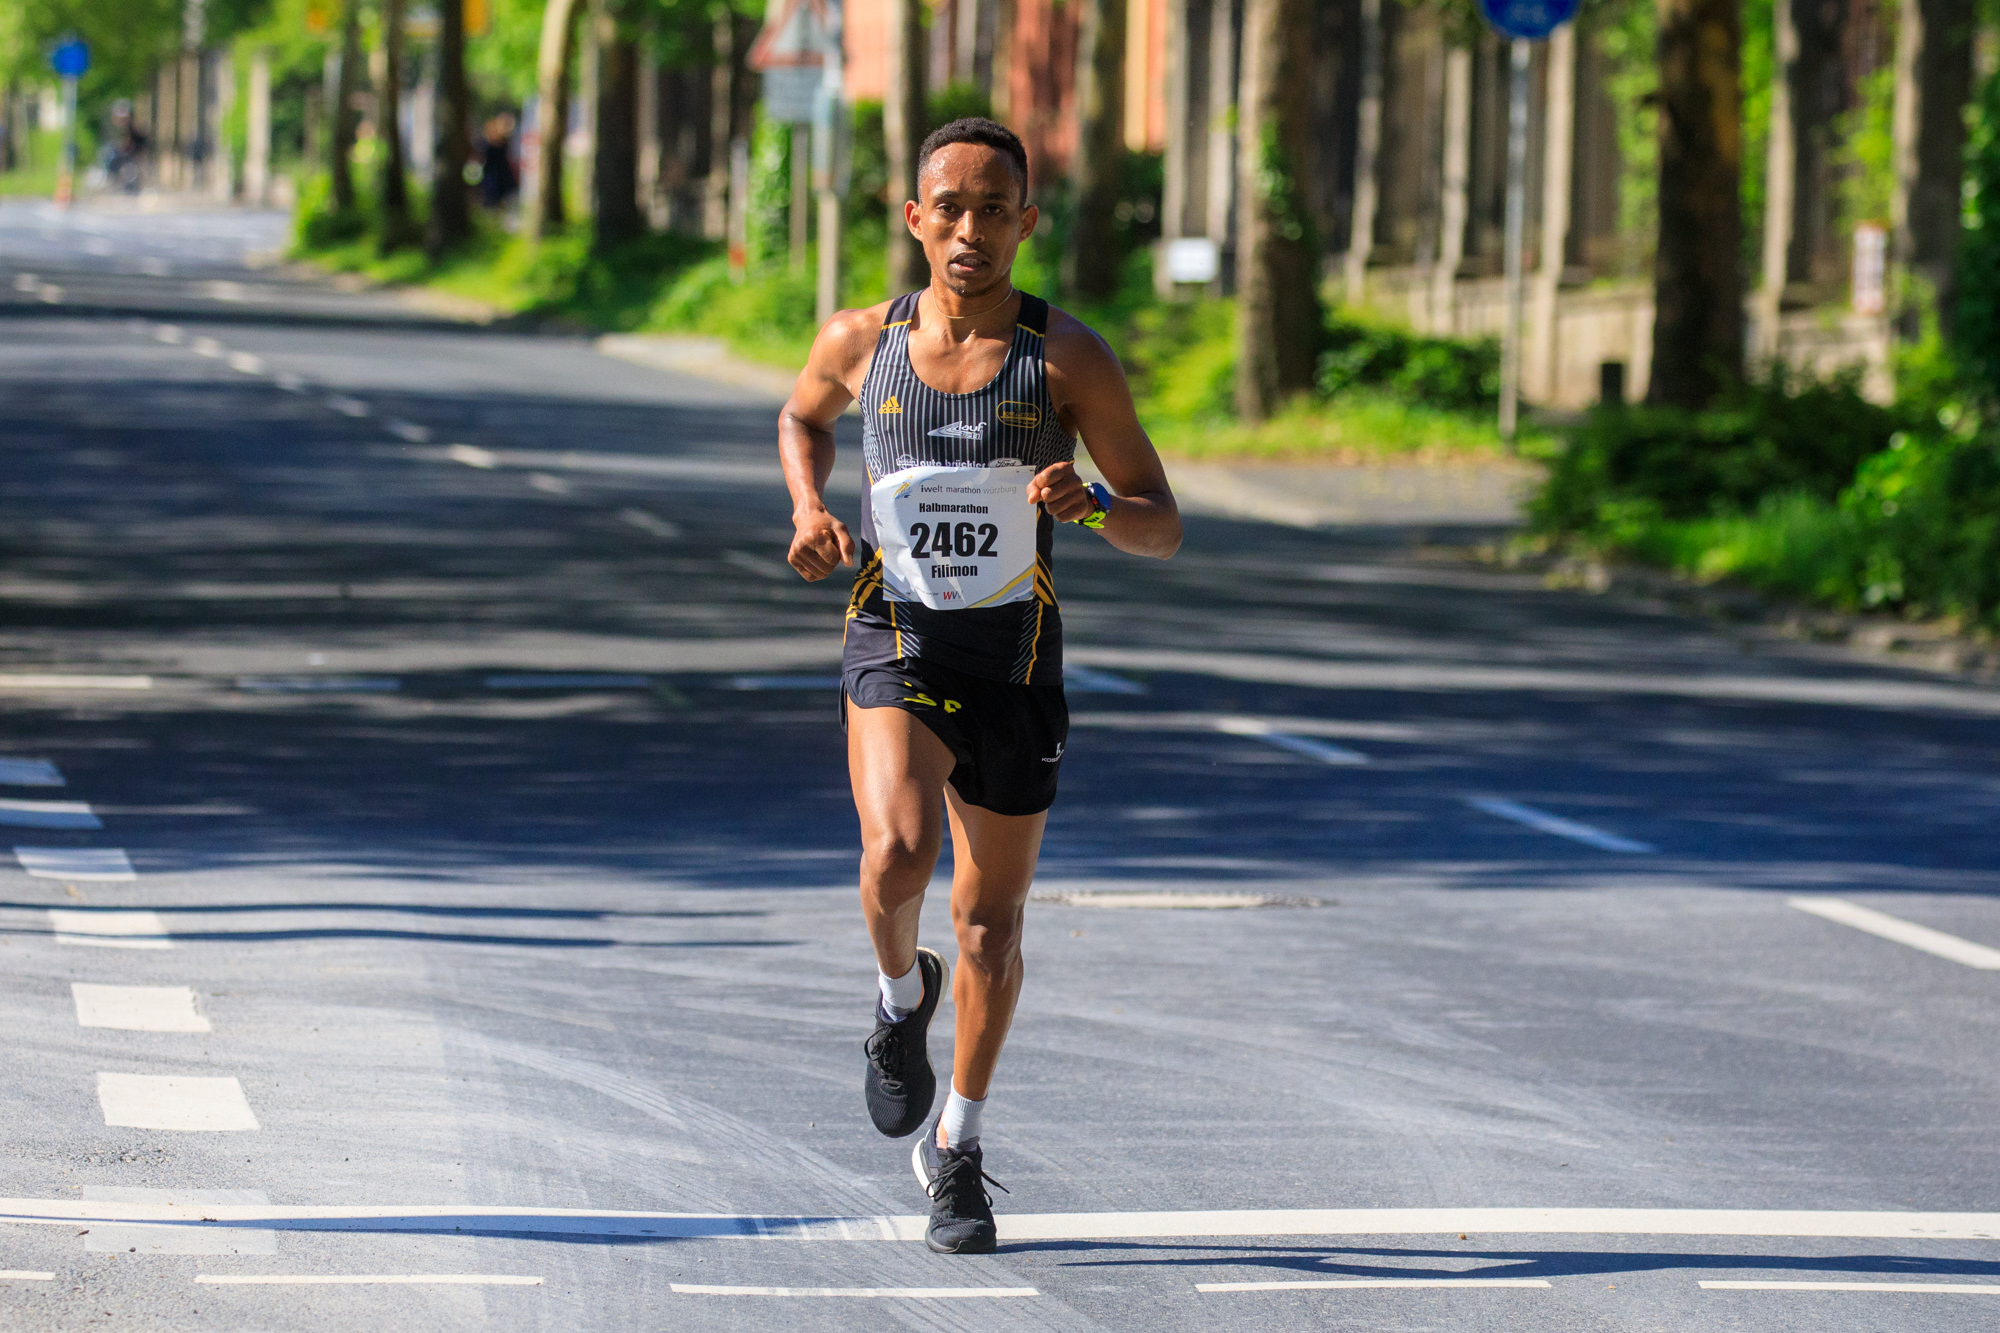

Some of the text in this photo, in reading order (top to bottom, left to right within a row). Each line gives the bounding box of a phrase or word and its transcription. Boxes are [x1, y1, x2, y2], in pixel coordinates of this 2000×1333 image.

[878, 406, 903, 414] adidas
[995, 459, 1016, 468] Ford
[921, 485, 1017, 494] iwelt marathon würzburg
[919, 503, 988, 514] Halbmarathon
[910, 522, 999, 559] 2462
[931, 564, 978, 578] Filimon
